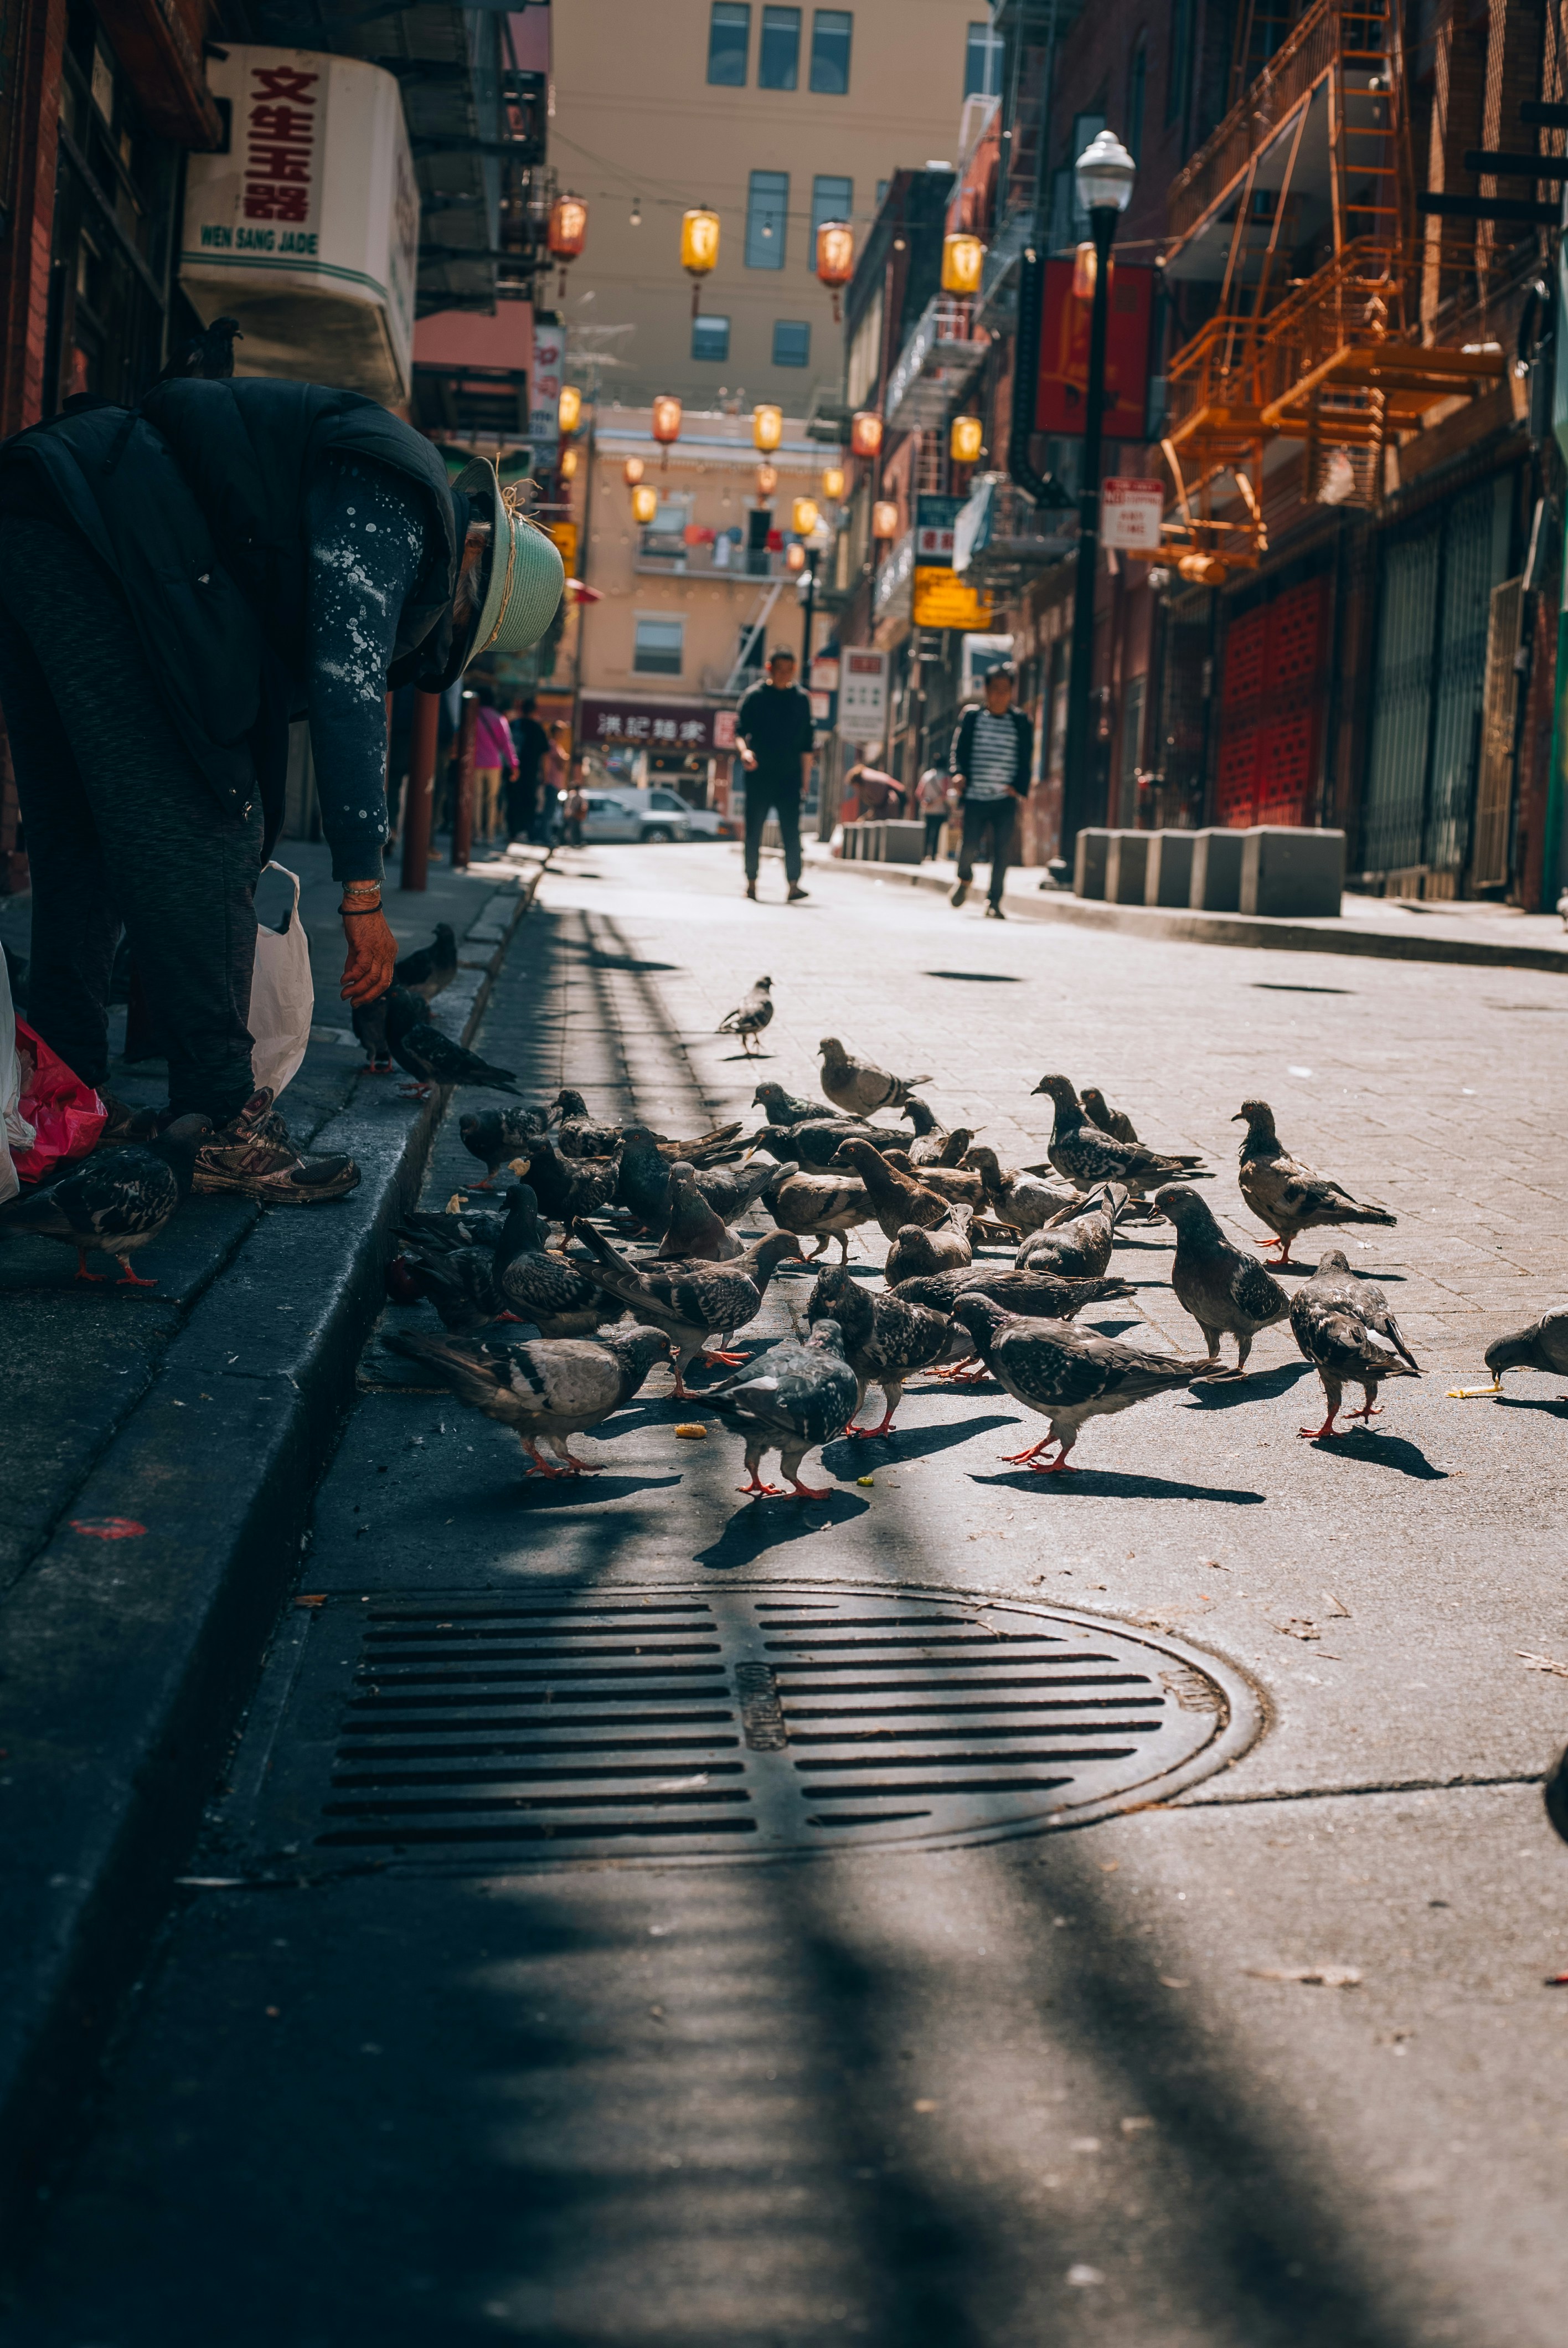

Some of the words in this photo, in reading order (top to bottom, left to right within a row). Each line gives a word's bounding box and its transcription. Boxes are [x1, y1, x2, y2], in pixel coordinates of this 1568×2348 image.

[245, 66, 318, 222] 文生玉器
[201, 225, 232, 249] WEN
[235, 227, 275, 251] SANG
[278, 231, 318, 255] JADE
